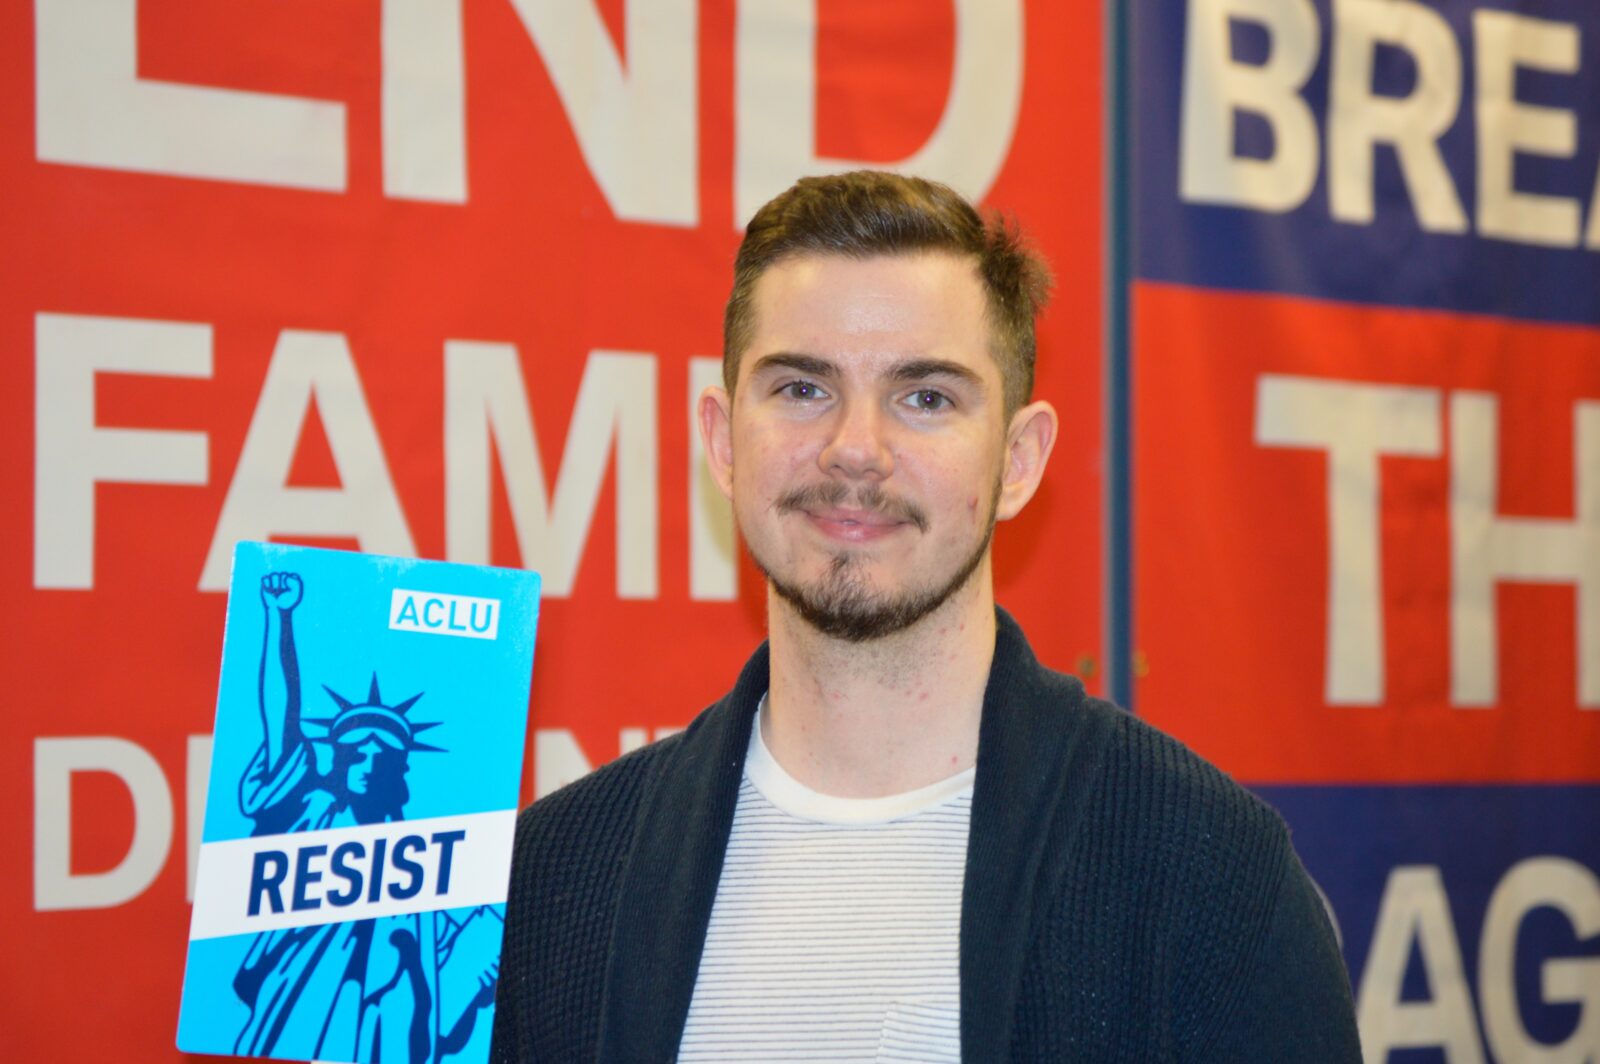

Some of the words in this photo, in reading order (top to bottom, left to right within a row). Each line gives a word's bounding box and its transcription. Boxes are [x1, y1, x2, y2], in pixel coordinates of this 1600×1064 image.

[1179, 0, 1600, 251] BRE
[34, 312, 738, 601] FAMI
[396, 595, 492, 633] ACLU
[246, 830, 466, 917] RESIST
[1306, 855, 1600, 1064] AG
